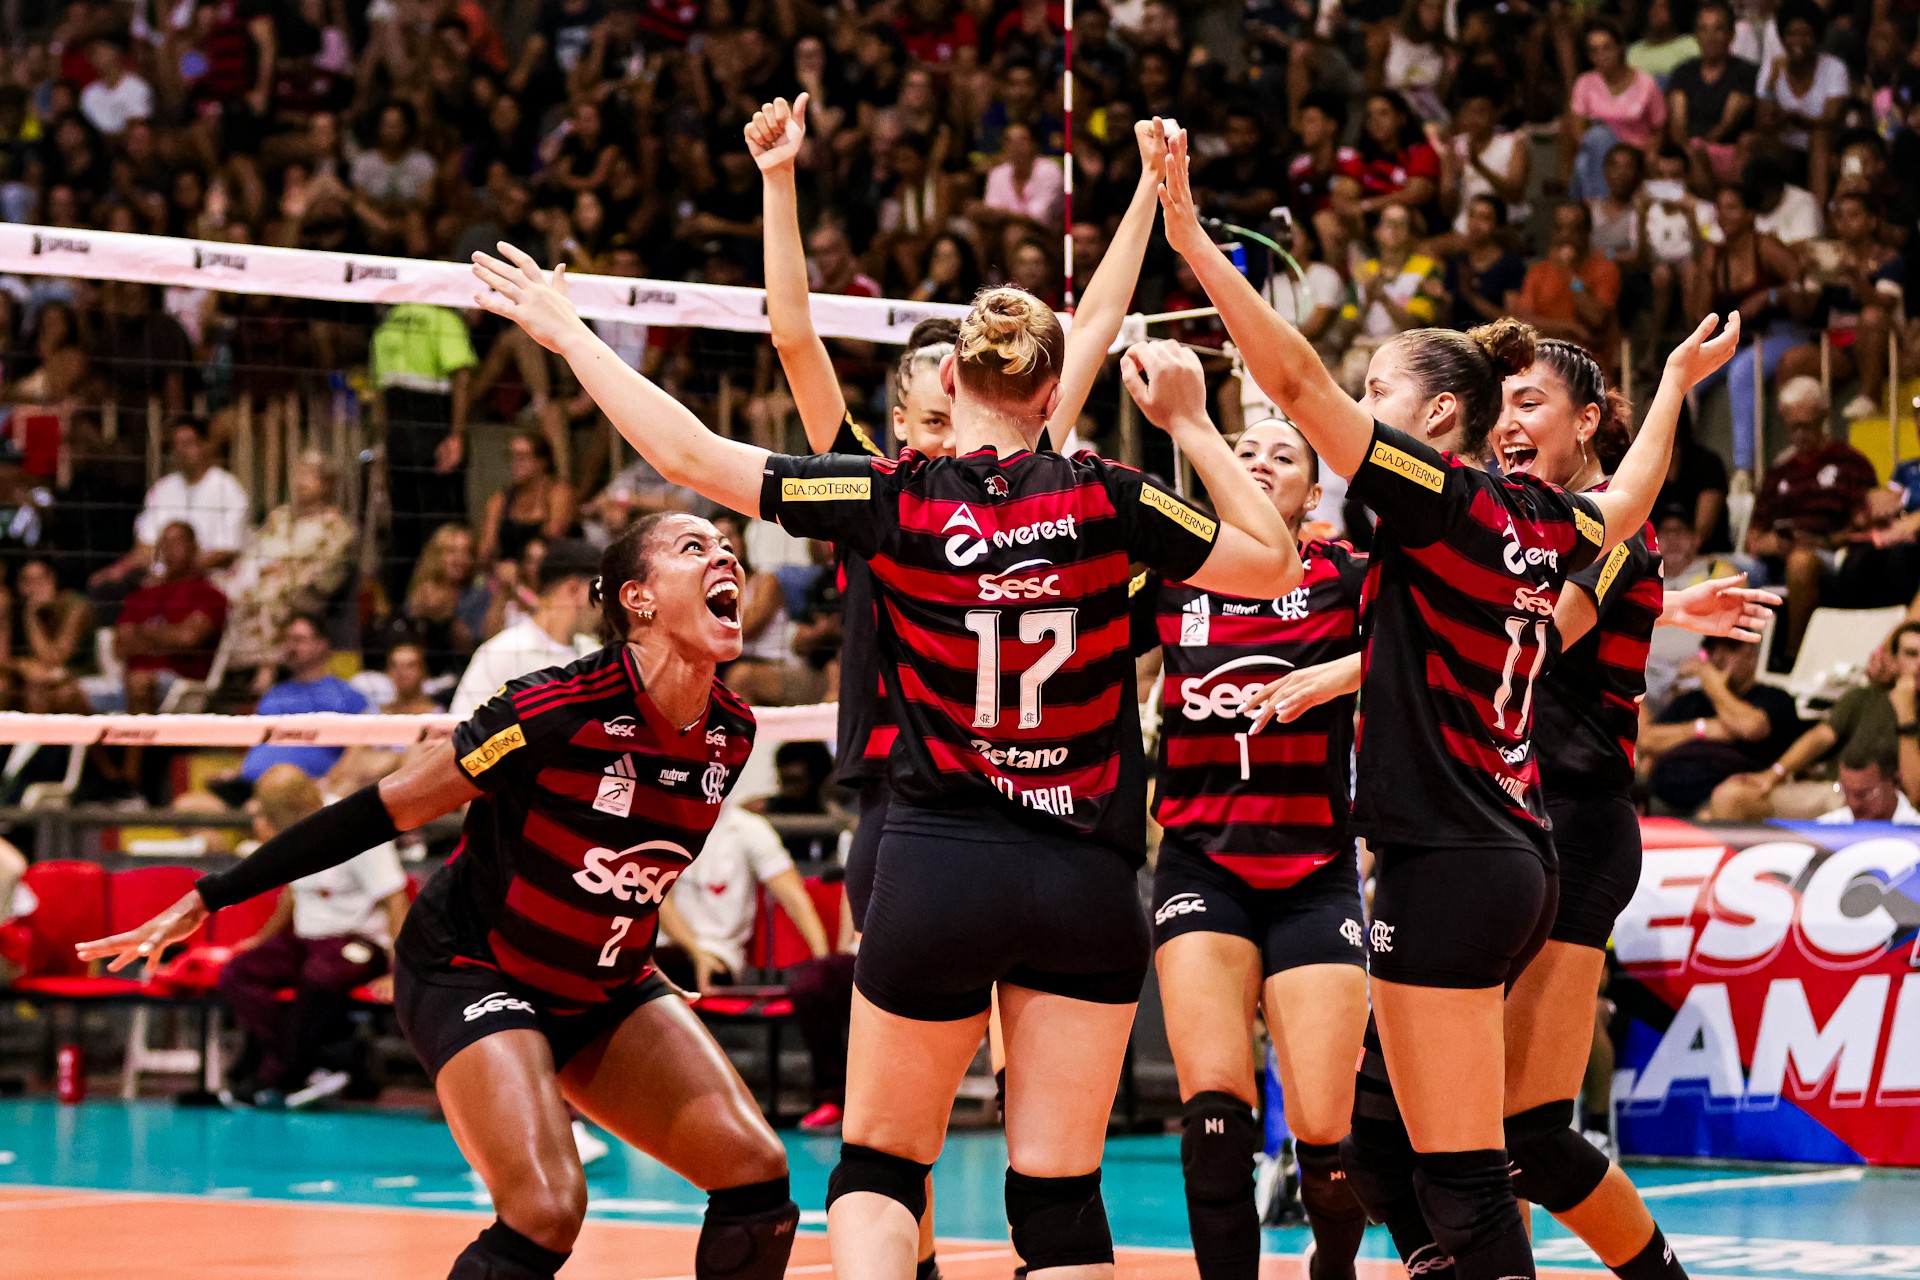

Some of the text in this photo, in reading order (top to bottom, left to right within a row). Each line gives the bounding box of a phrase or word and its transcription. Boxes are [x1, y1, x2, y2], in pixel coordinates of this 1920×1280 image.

[992, 513, 1078, 549] everest
[964, 607, 1079, 729] 17
[1492, 615, 1549, 735] 11
[1233, 732, 1251, 780] 1
[597, 915, 634, 967] 2
